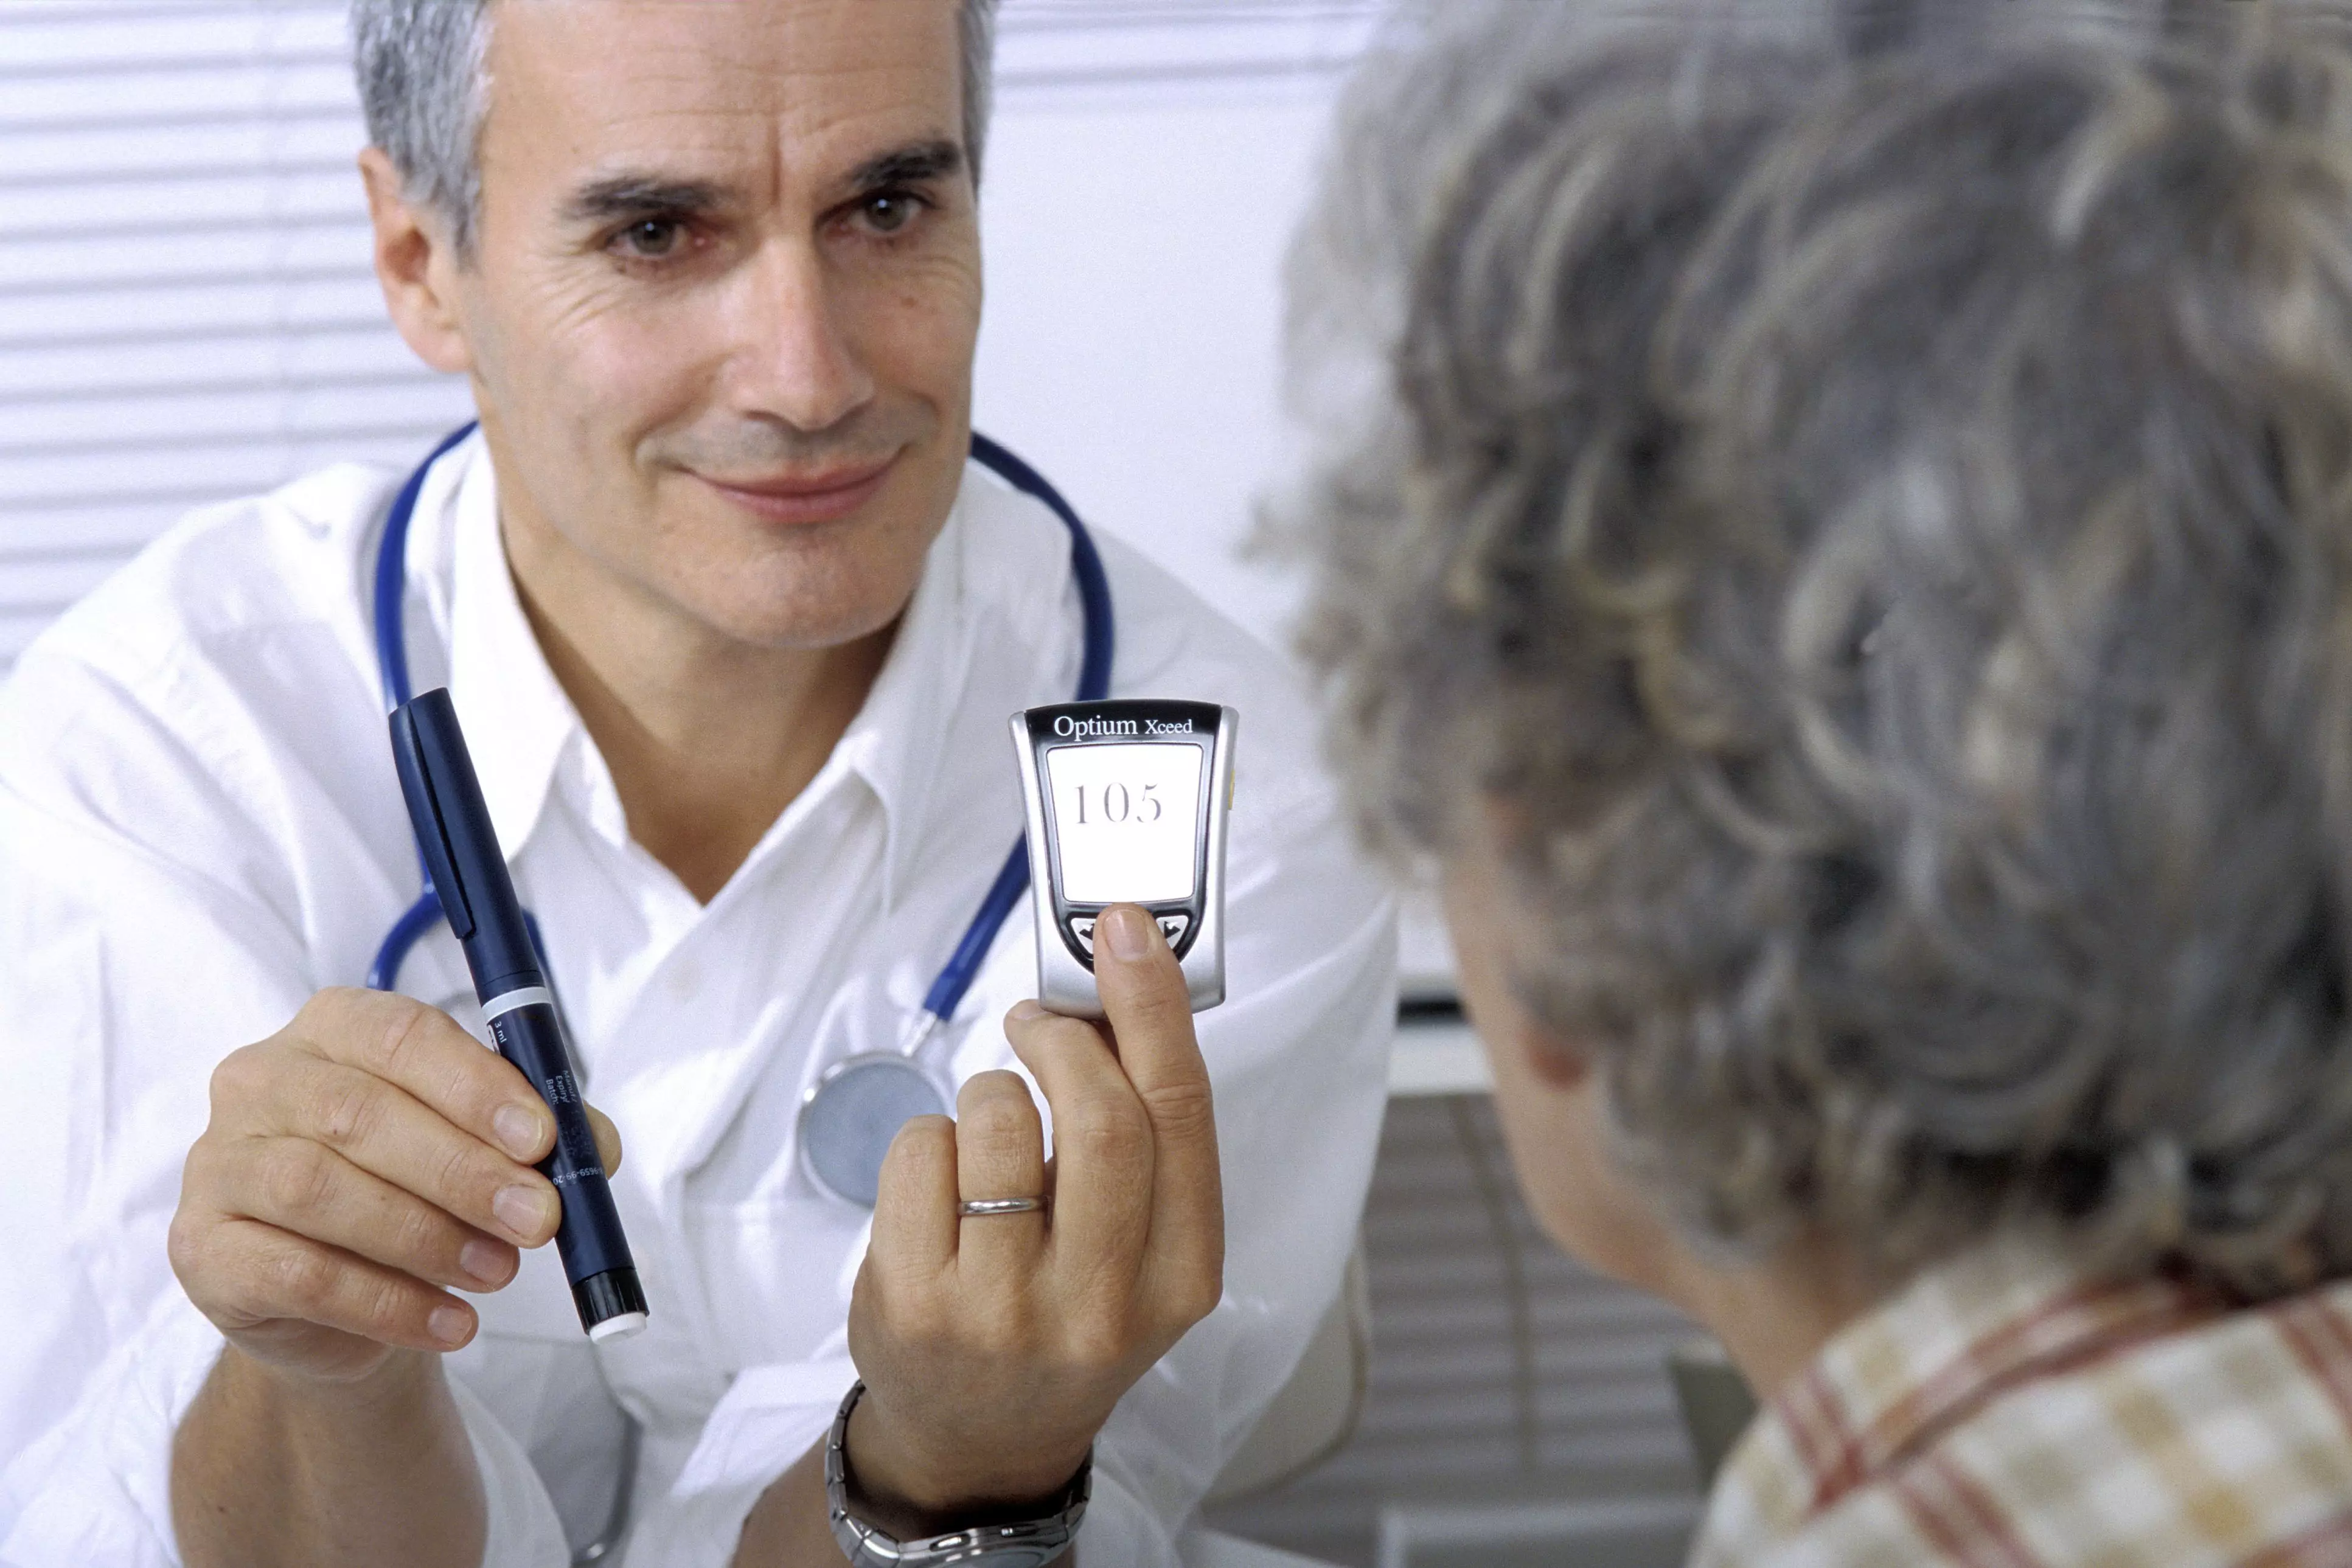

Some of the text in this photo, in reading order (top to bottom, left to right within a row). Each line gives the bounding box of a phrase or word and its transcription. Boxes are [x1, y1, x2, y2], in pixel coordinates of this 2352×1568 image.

[1054, 715, 1193, 741] Optium Xceed
[1074, 782, 1161, 824] 105
[497, 1030, 507, 1043] ml
[546, 1079, 558, 1105] Batch:
